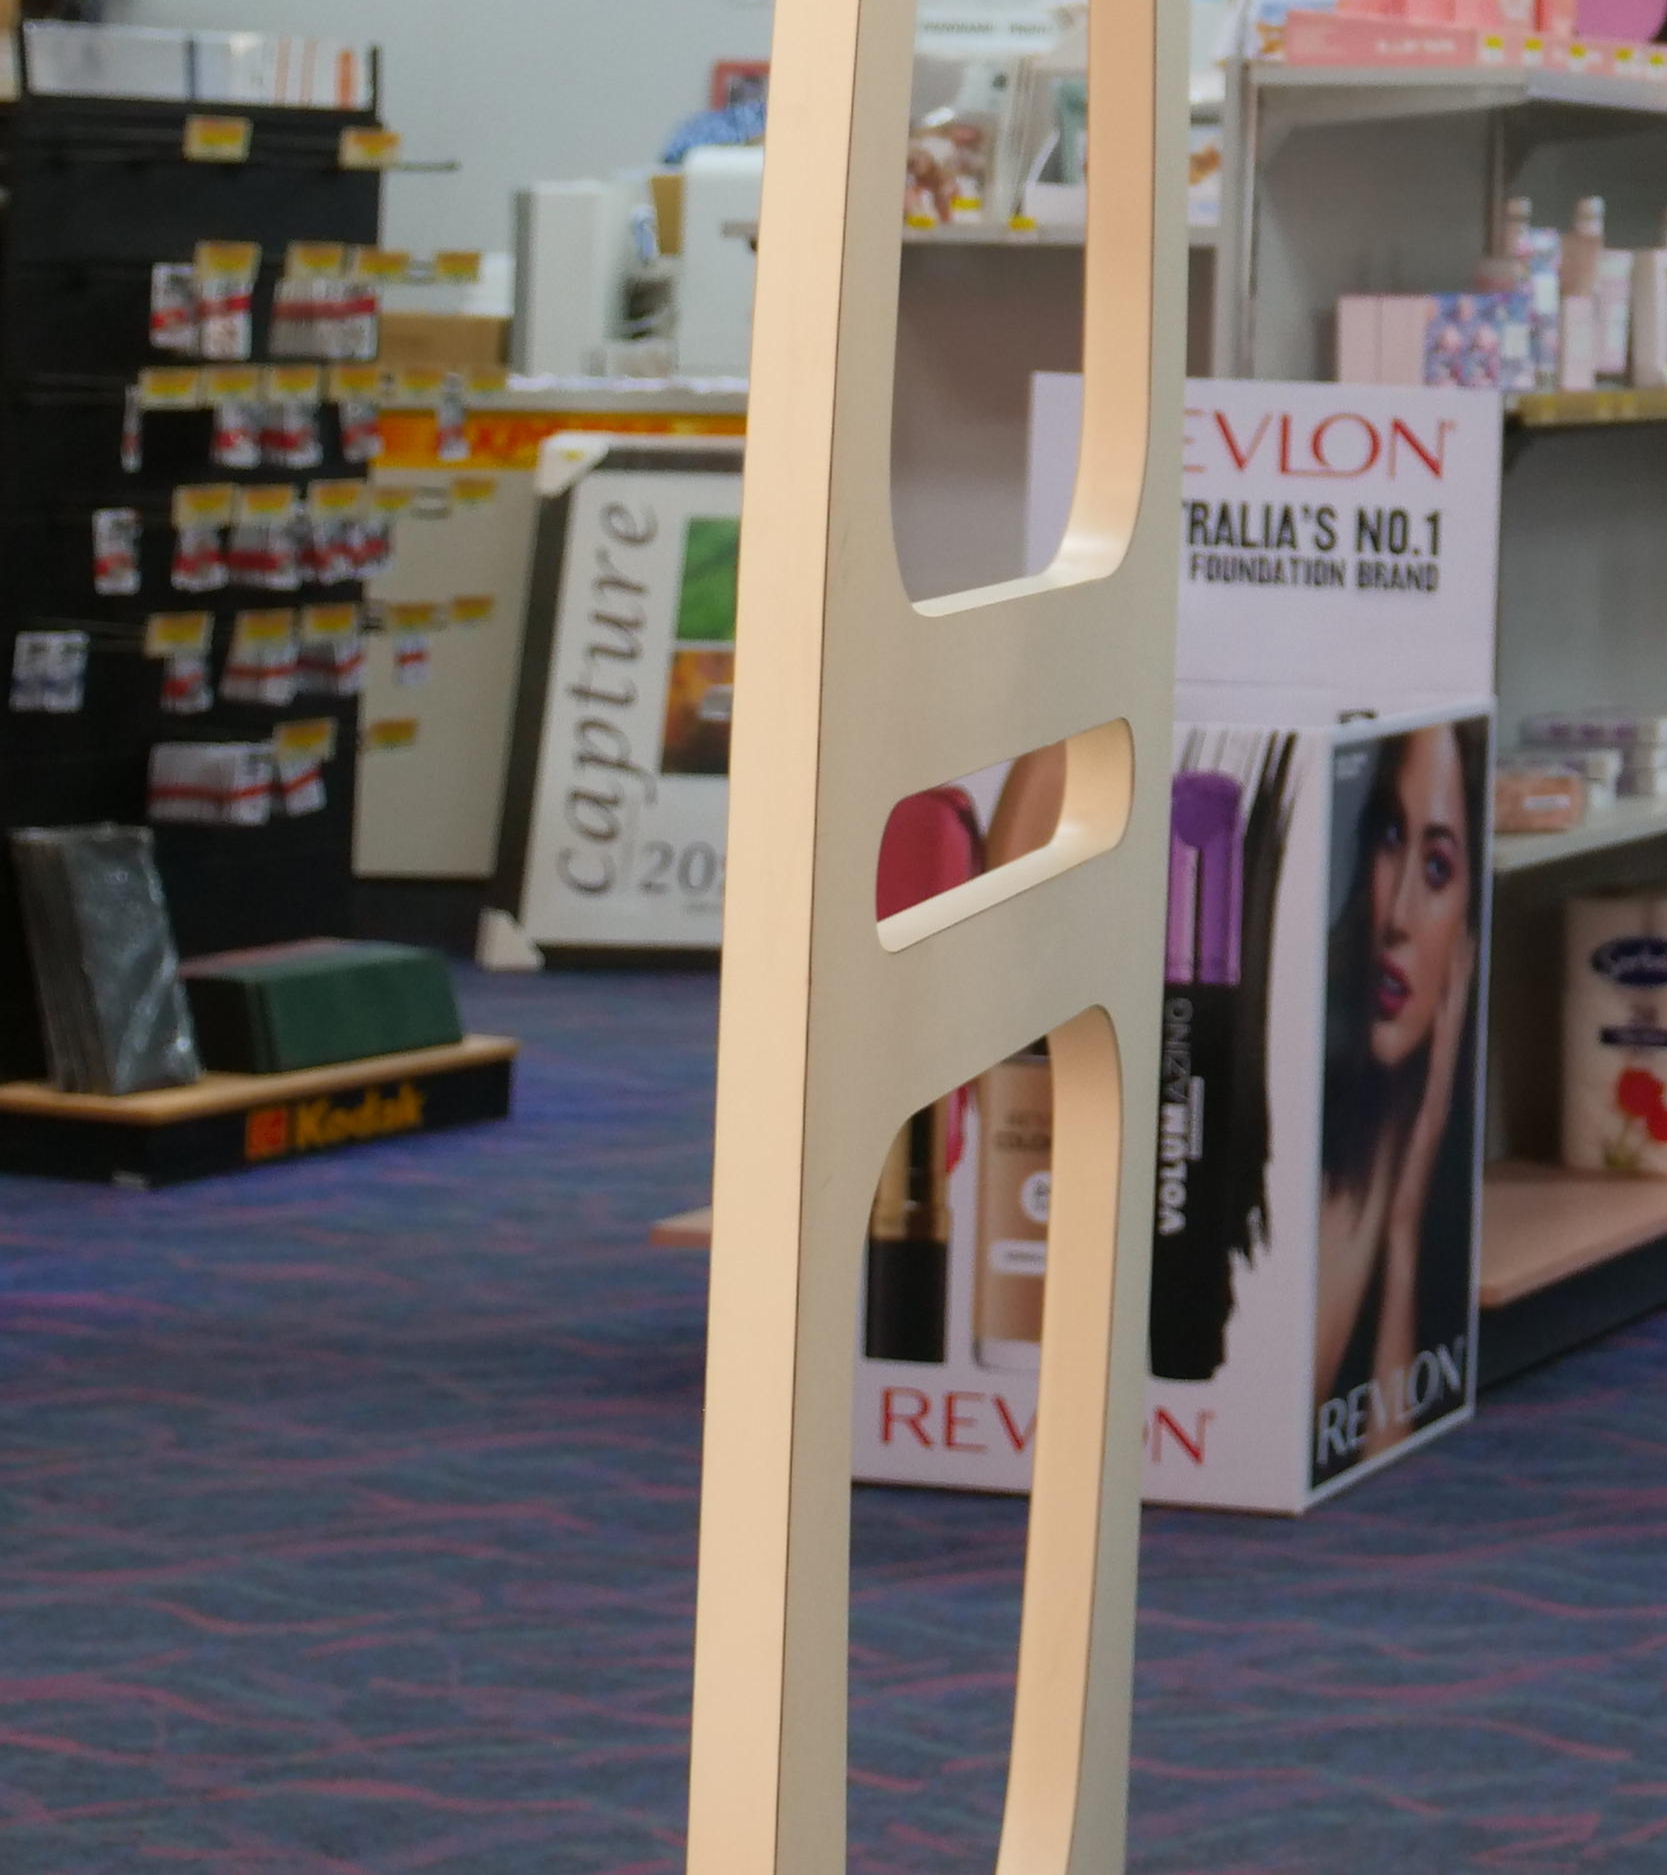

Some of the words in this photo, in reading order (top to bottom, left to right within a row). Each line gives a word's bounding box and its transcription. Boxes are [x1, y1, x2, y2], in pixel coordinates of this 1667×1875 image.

[1183, 409, 1443, 480] VLON
[1183, 500, 1338, 553] RALIA'S
[1354, 505, 1443, 558] NO.1
[1189, 554, 1347, 590] FOUNDATION
[1355, 561, 1440, 594] BRAND
[639, 839, 725, 896] 20
[295, 1082, 423, 1149] Kodak
[880, 1386, 1207, 1465] REVN
[1316, 1336, 1467, 1468] REVLON
